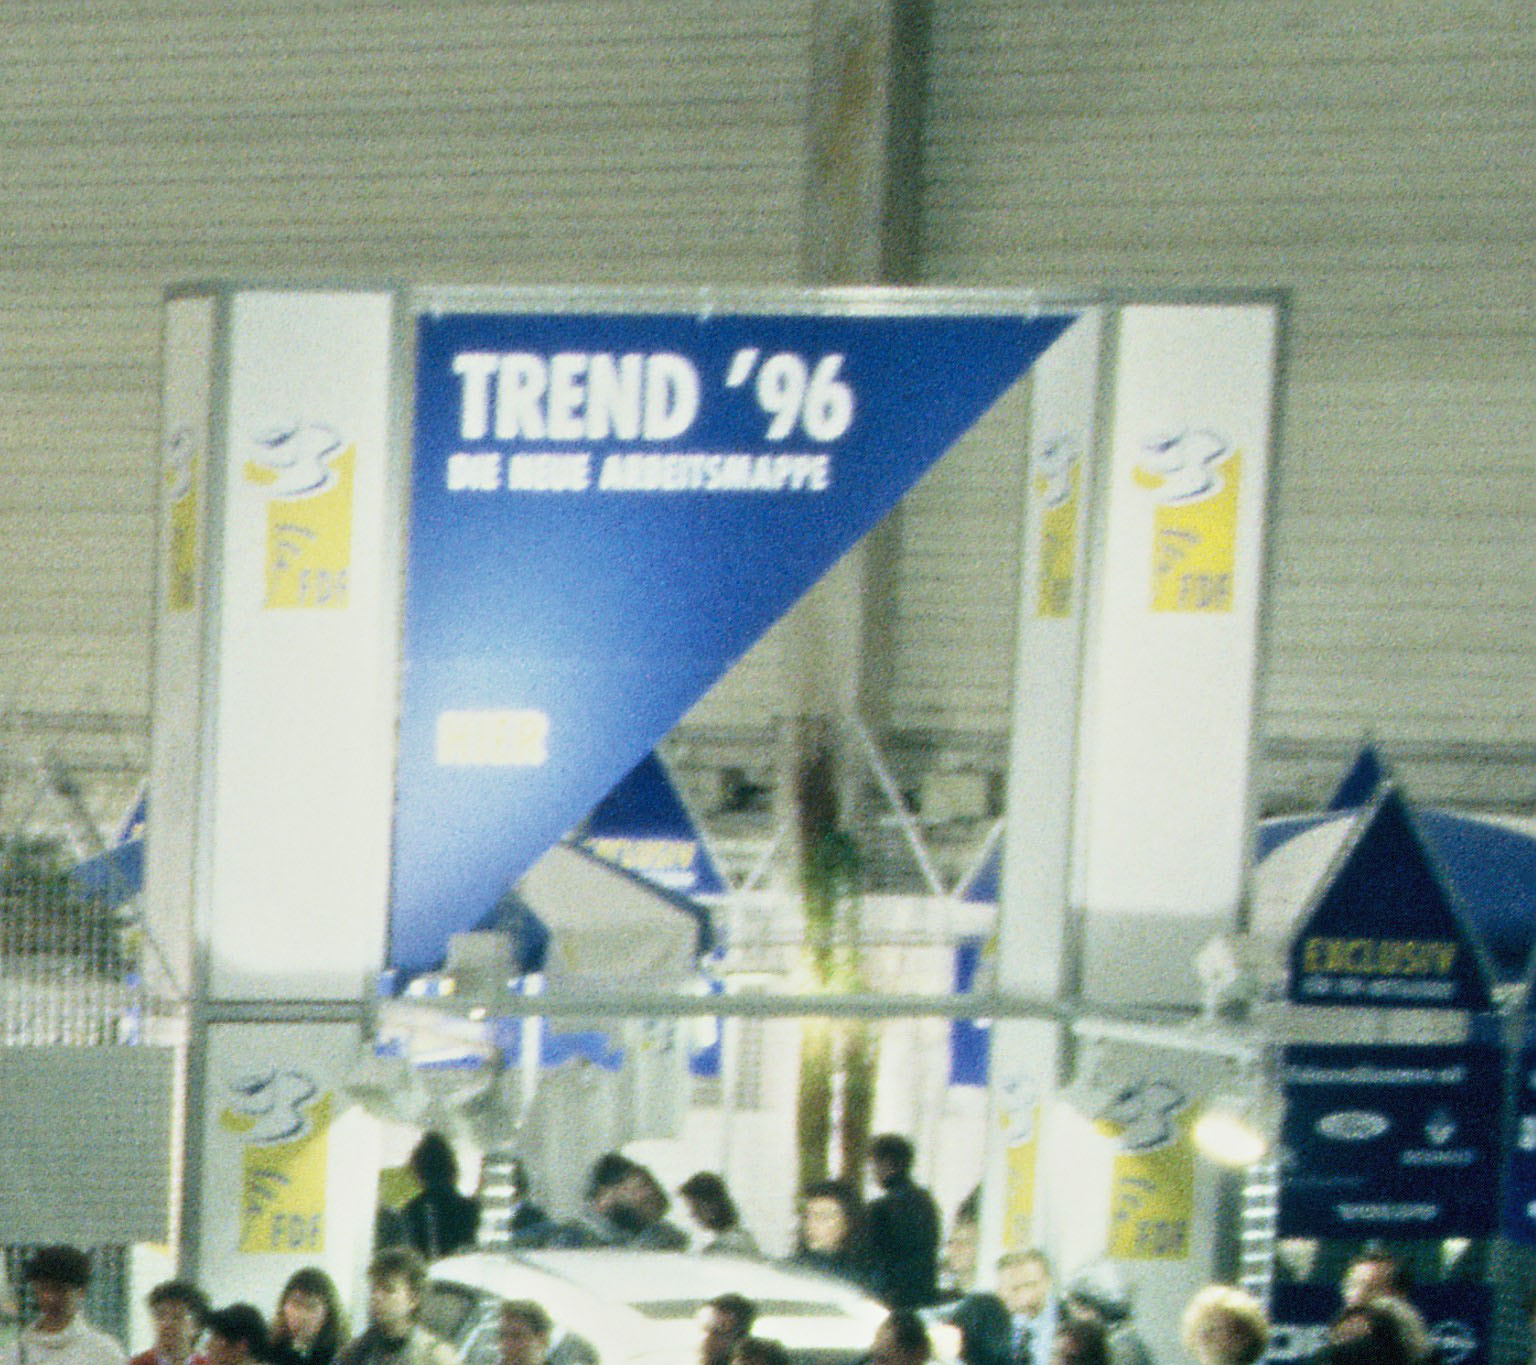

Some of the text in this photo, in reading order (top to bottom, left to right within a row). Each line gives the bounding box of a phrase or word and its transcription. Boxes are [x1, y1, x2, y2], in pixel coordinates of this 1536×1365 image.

[452, 352, 701, 441] TREND
[446, 452, 501, 491] DIE
[508, 453, 591, 491] NEUE
